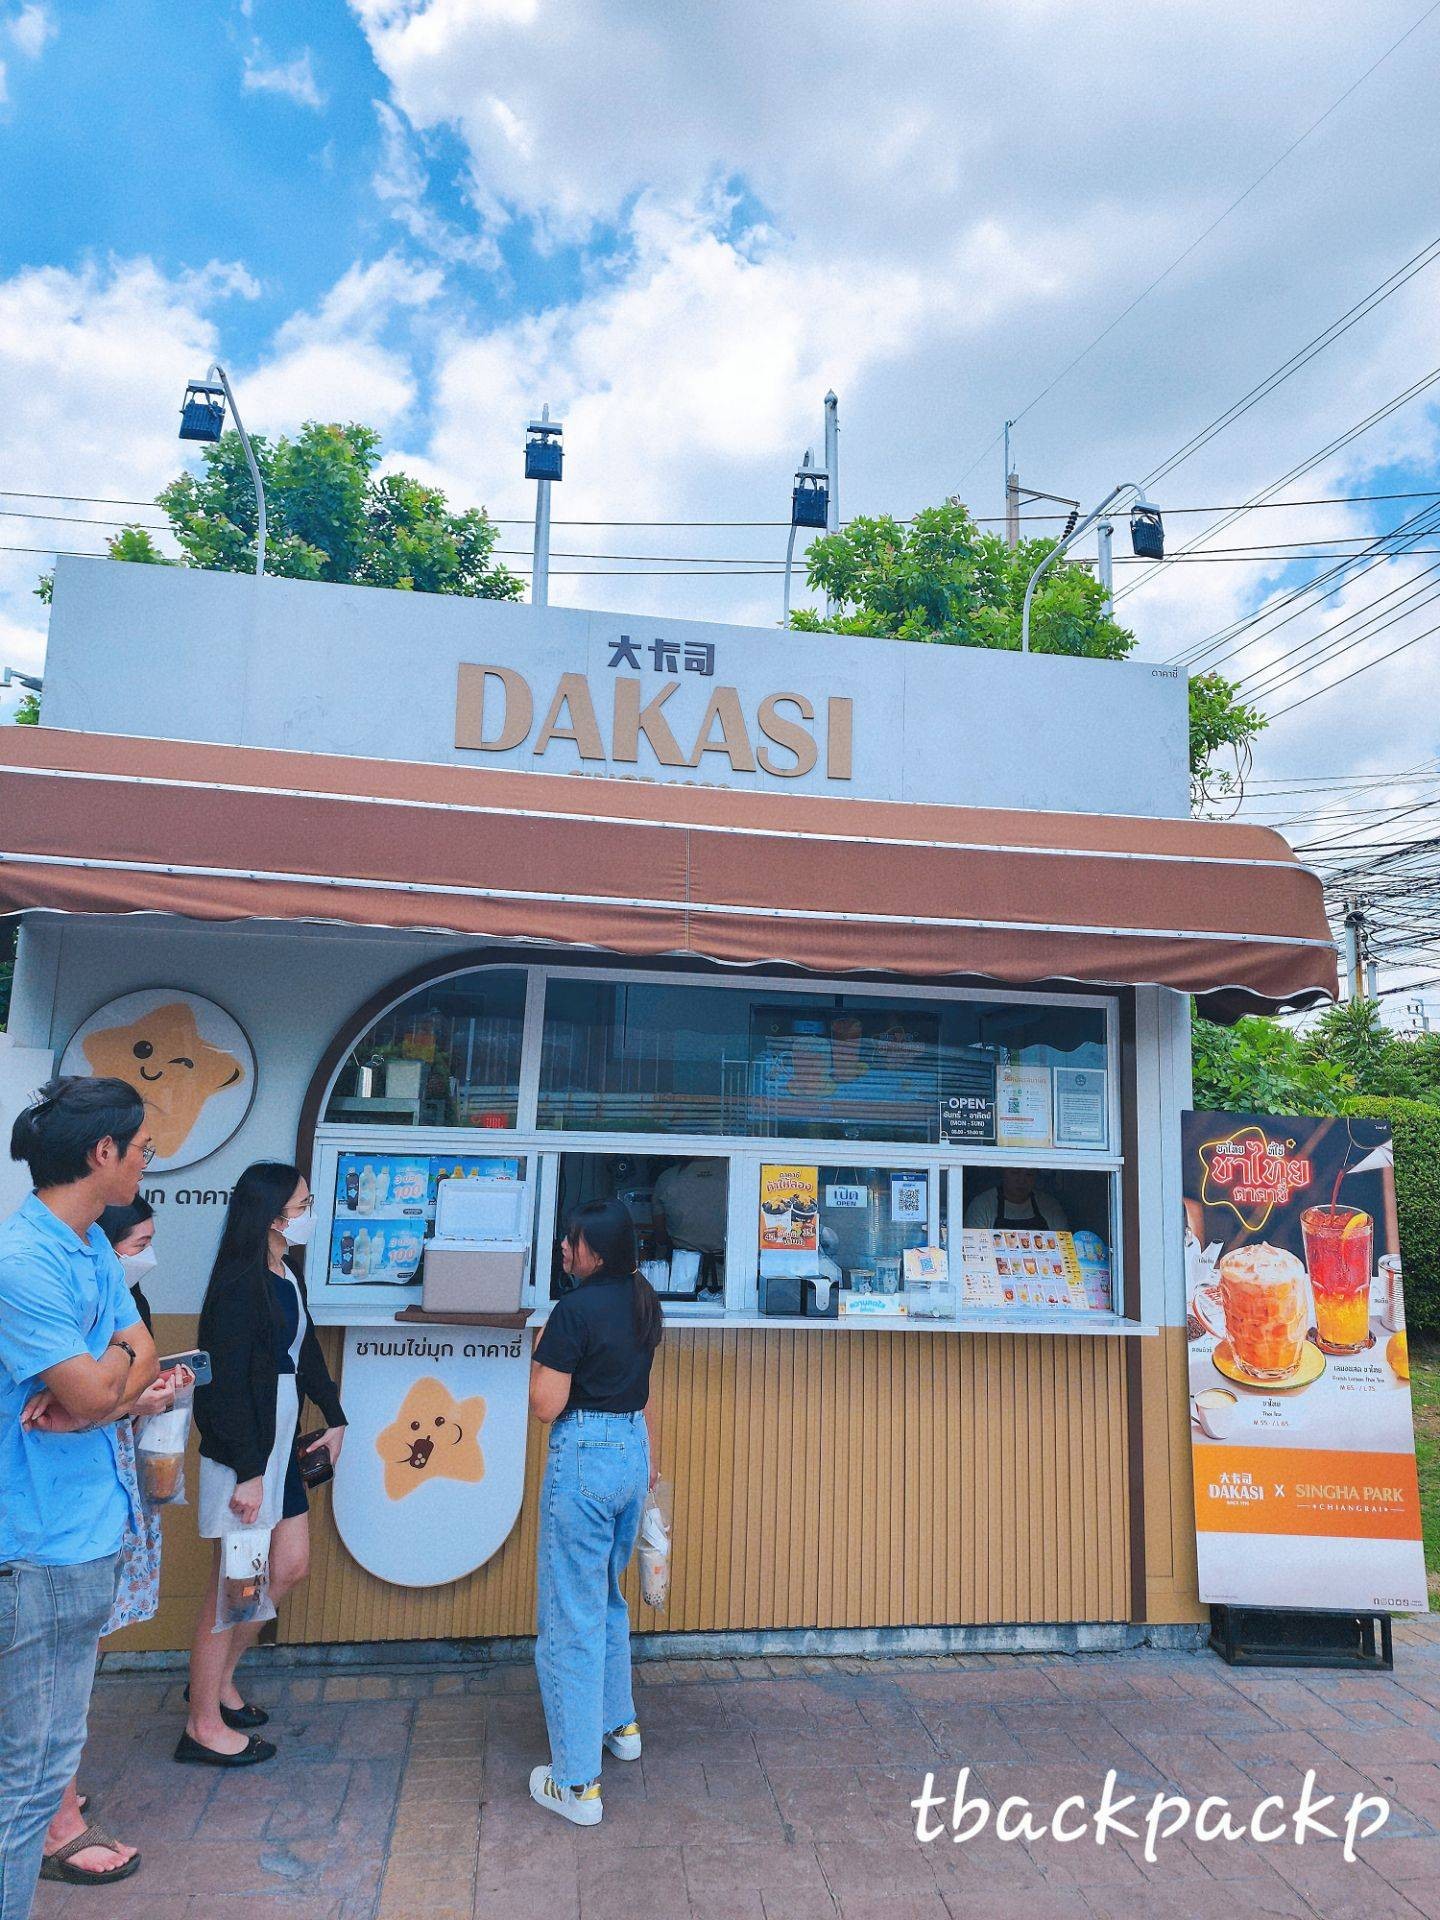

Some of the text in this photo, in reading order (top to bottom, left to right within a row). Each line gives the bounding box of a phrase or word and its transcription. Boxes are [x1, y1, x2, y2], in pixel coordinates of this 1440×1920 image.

[608, 635, 715, 675] 大卡司
[454, 662, 854, 780] DAKASI
[949, 1097, 986, 1110] OPEN
[1212, 1140, 1310, 1186] ชาไทย
[175, 1186, 234, 1205] ดาคา
[356, 1337, 454, 1362] ชานมไข่มุก
[1208, 1484, 1264, 1500] DAKASI
[1295, 1483, 1404, 1502] SINGHA PARK
[1319, 1504, 1382, 1513] CHIANGRAI
